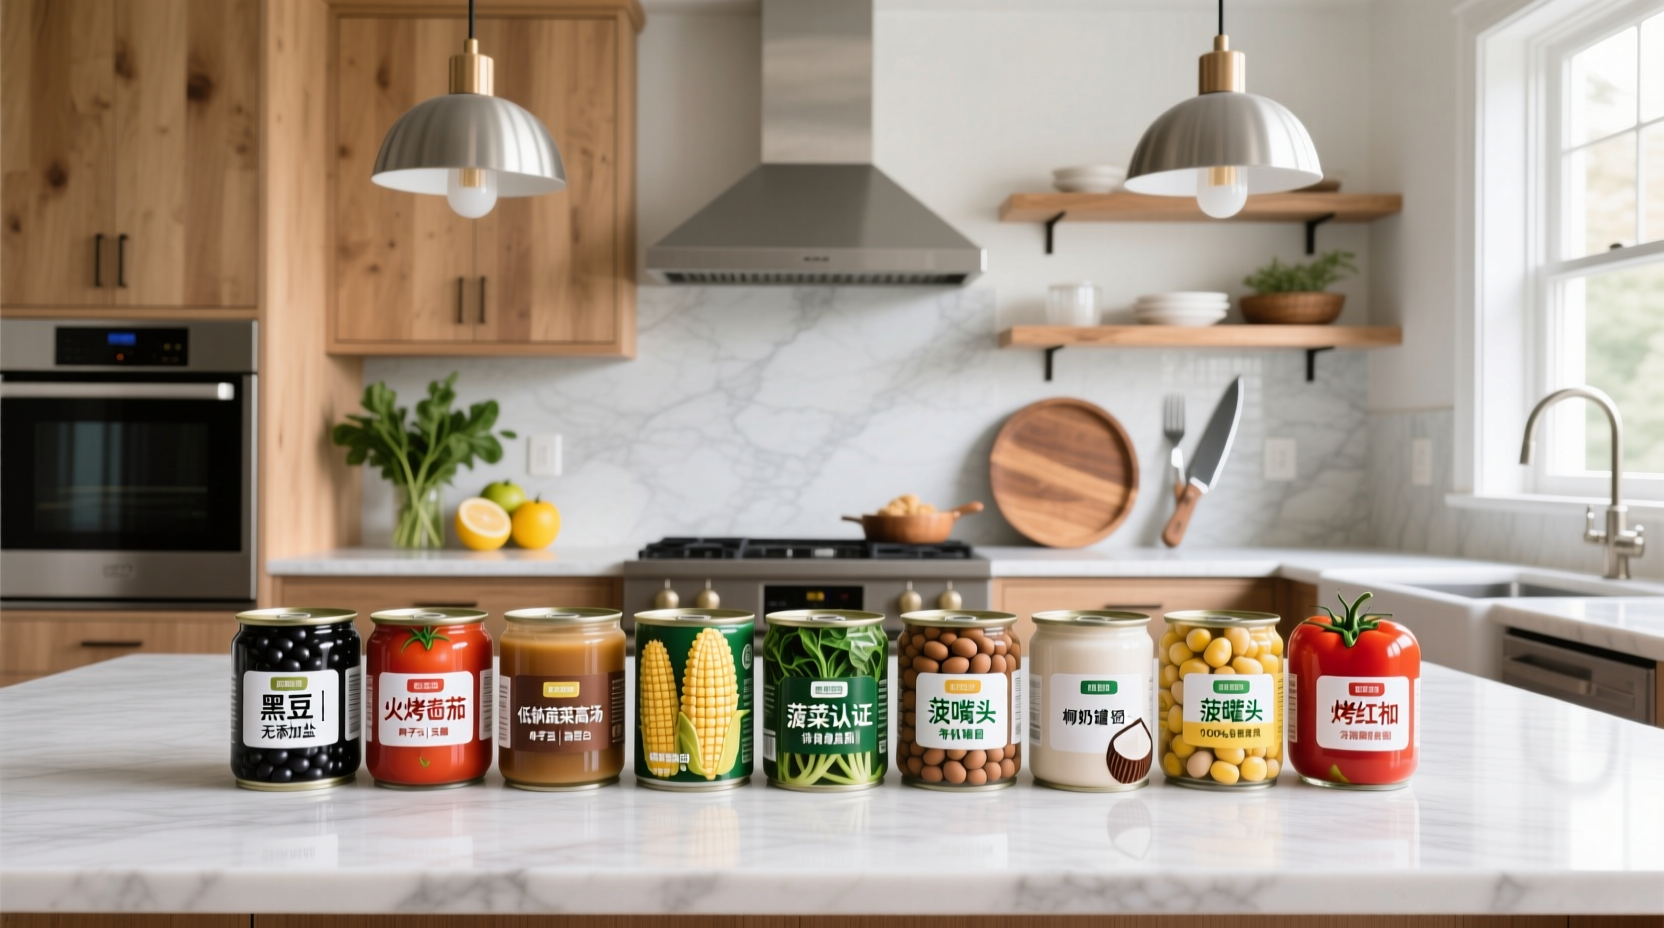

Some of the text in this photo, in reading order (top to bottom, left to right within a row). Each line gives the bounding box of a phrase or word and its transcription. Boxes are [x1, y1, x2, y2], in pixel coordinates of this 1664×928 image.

[261, 694, 313, 721] 黑豆
[787, 702, 873, 729] 菠菜认证
[261, 722, 316, 739] 无添加盐
